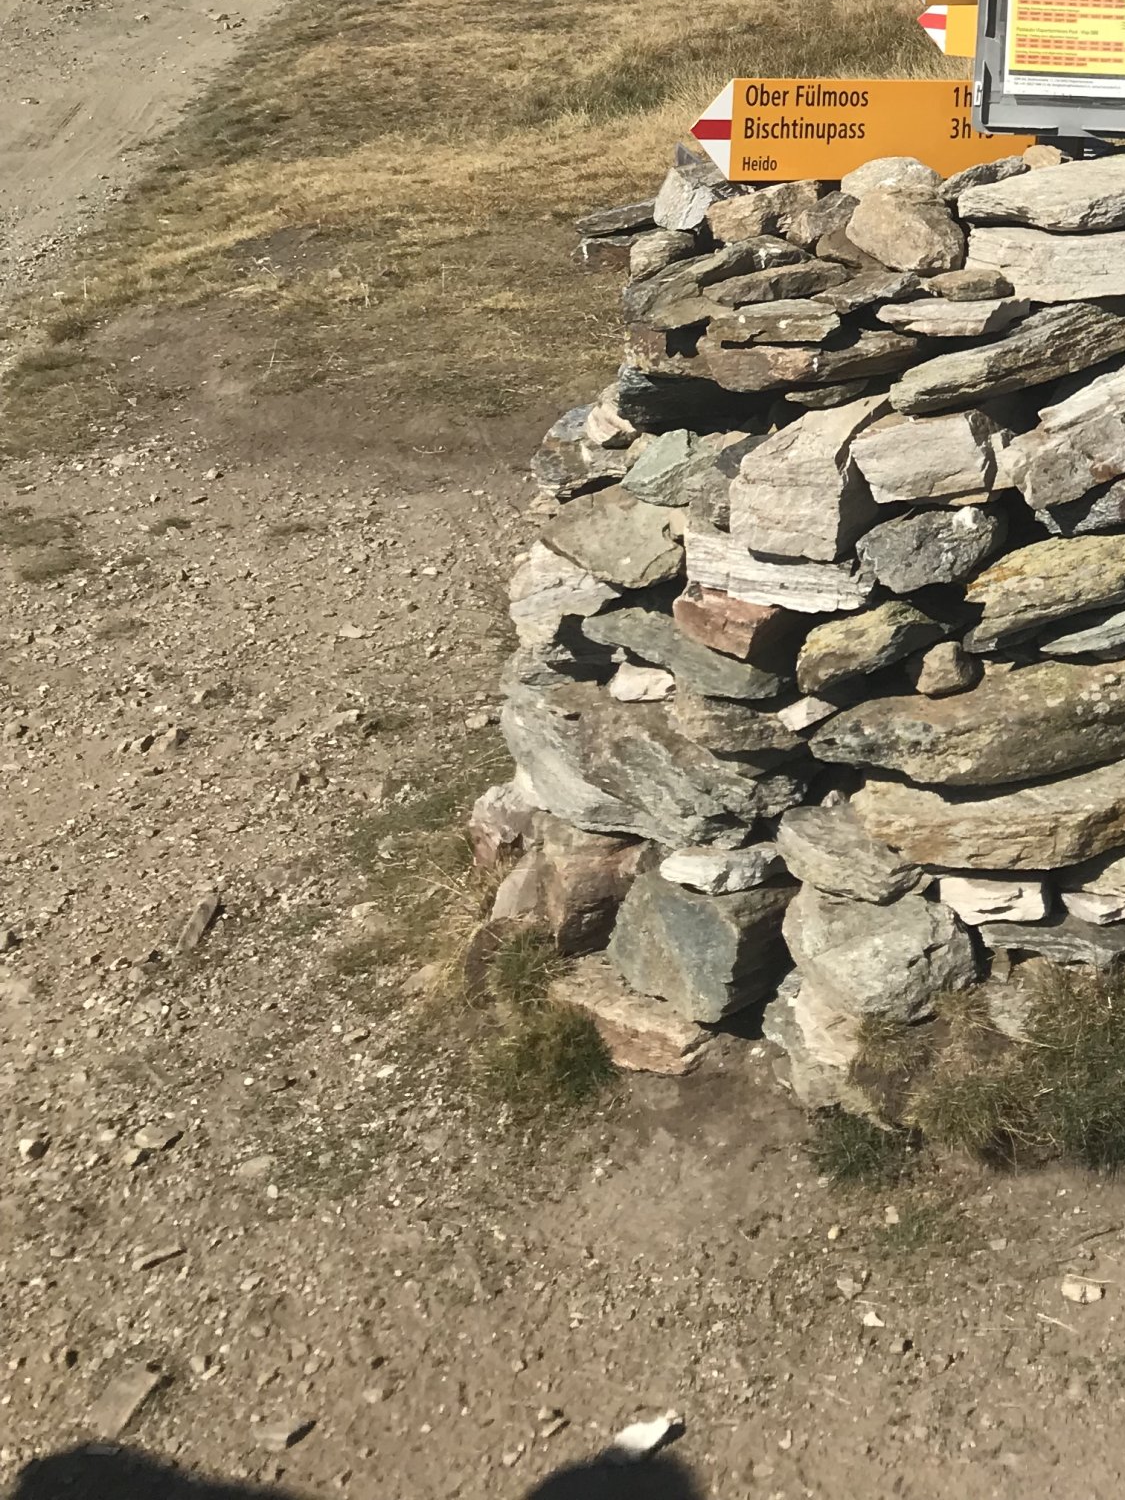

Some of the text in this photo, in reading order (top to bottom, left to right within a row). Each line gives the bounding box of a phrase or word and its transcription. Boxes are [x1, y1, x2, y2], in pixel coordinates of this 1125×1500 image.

[745, 84, 789, 107] Ober
[795, 84, 869, 108] Fülmoos
[743, 116, 865, 145] Bischtinupass
[742, 156, 778, 171] Heido
